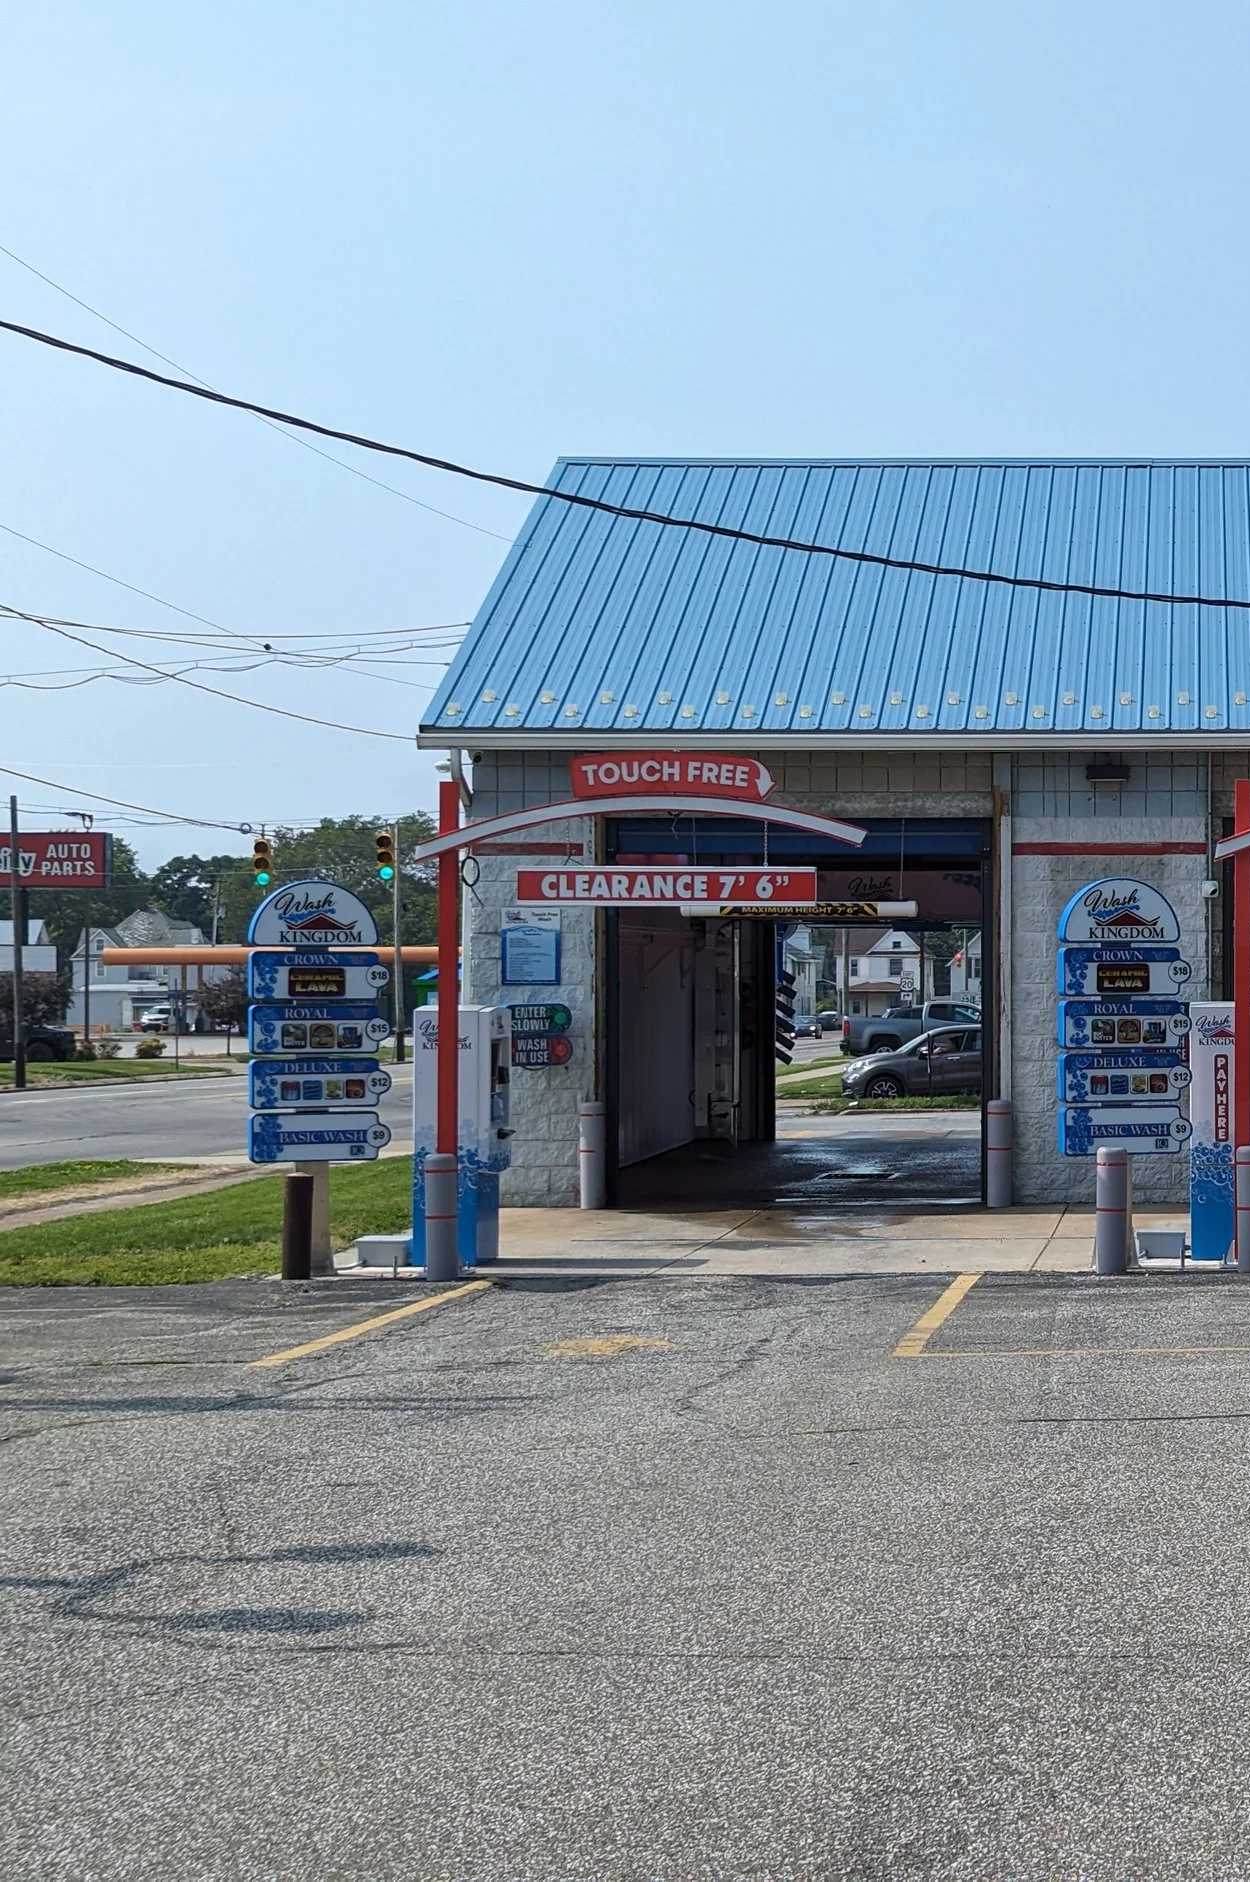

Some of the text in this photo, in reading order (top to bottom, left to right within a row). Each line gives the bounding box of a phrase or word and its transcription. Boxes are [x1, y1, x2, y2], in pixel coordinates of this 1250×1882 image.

[582, 760, 750, 788] TOUCH FREE
[46, 843, 91, 858] AUTO
[41, 860, 95, 876] PARTS
[541, 874, 708, 898] CLEARANCE
[274, 892, 335, 915] Wash
[1084, 889, 1139, 912] Wash
[741, 906, 796, 914] MAXIMUM
[797, 906, 832, 914] HEIGHT
[280, 930, 362, 943] KINGDOM
[1089, 926, 1165, 939] KINGDOM
[284, 953, 339, 966] CROWN
[1093, 950, 1144, 961] CROWN
[371, 970, 388, 981] $18
[1173, 966, 1188, 976] $18
[295, 982, 338, 992] LAVA
[902, 980, 913, 989] 20
[1104, 978, 1143, 988] LAVA
[285, 1008, 331, 1019] ROYAL
[515, 1006, 547, 1018] ENTER
[1094, 1003, 1137, 1014] ROYAL
[511, 1019, 551, 1031] SLOWLY
[1173, 1019, 1188, 1029] $15
[1195, 1015, 1231, 1029] Wash
[371, 1023, 388, 1034] $15
[517, 1038, 548, 1050] WASH
[1199, 1037, 1235, 1046] KINGD
[516, 1051, 549, 1063] IN USE
[1094, 1056, 1147, 1067] DELUXE
[284, 1061, 343, 1073] DELUXE
[371, 1077, 388, 1087] $12
[1173, 1072, 1188, 1082] $12
[1090, 1124, 1168, 1136] BASIC WASH
[1175, 1123, 1187, 1134] $9
[279, 1130, 365, 1144] BASIC WASH
[372, 1129, 385, 1141] $9
